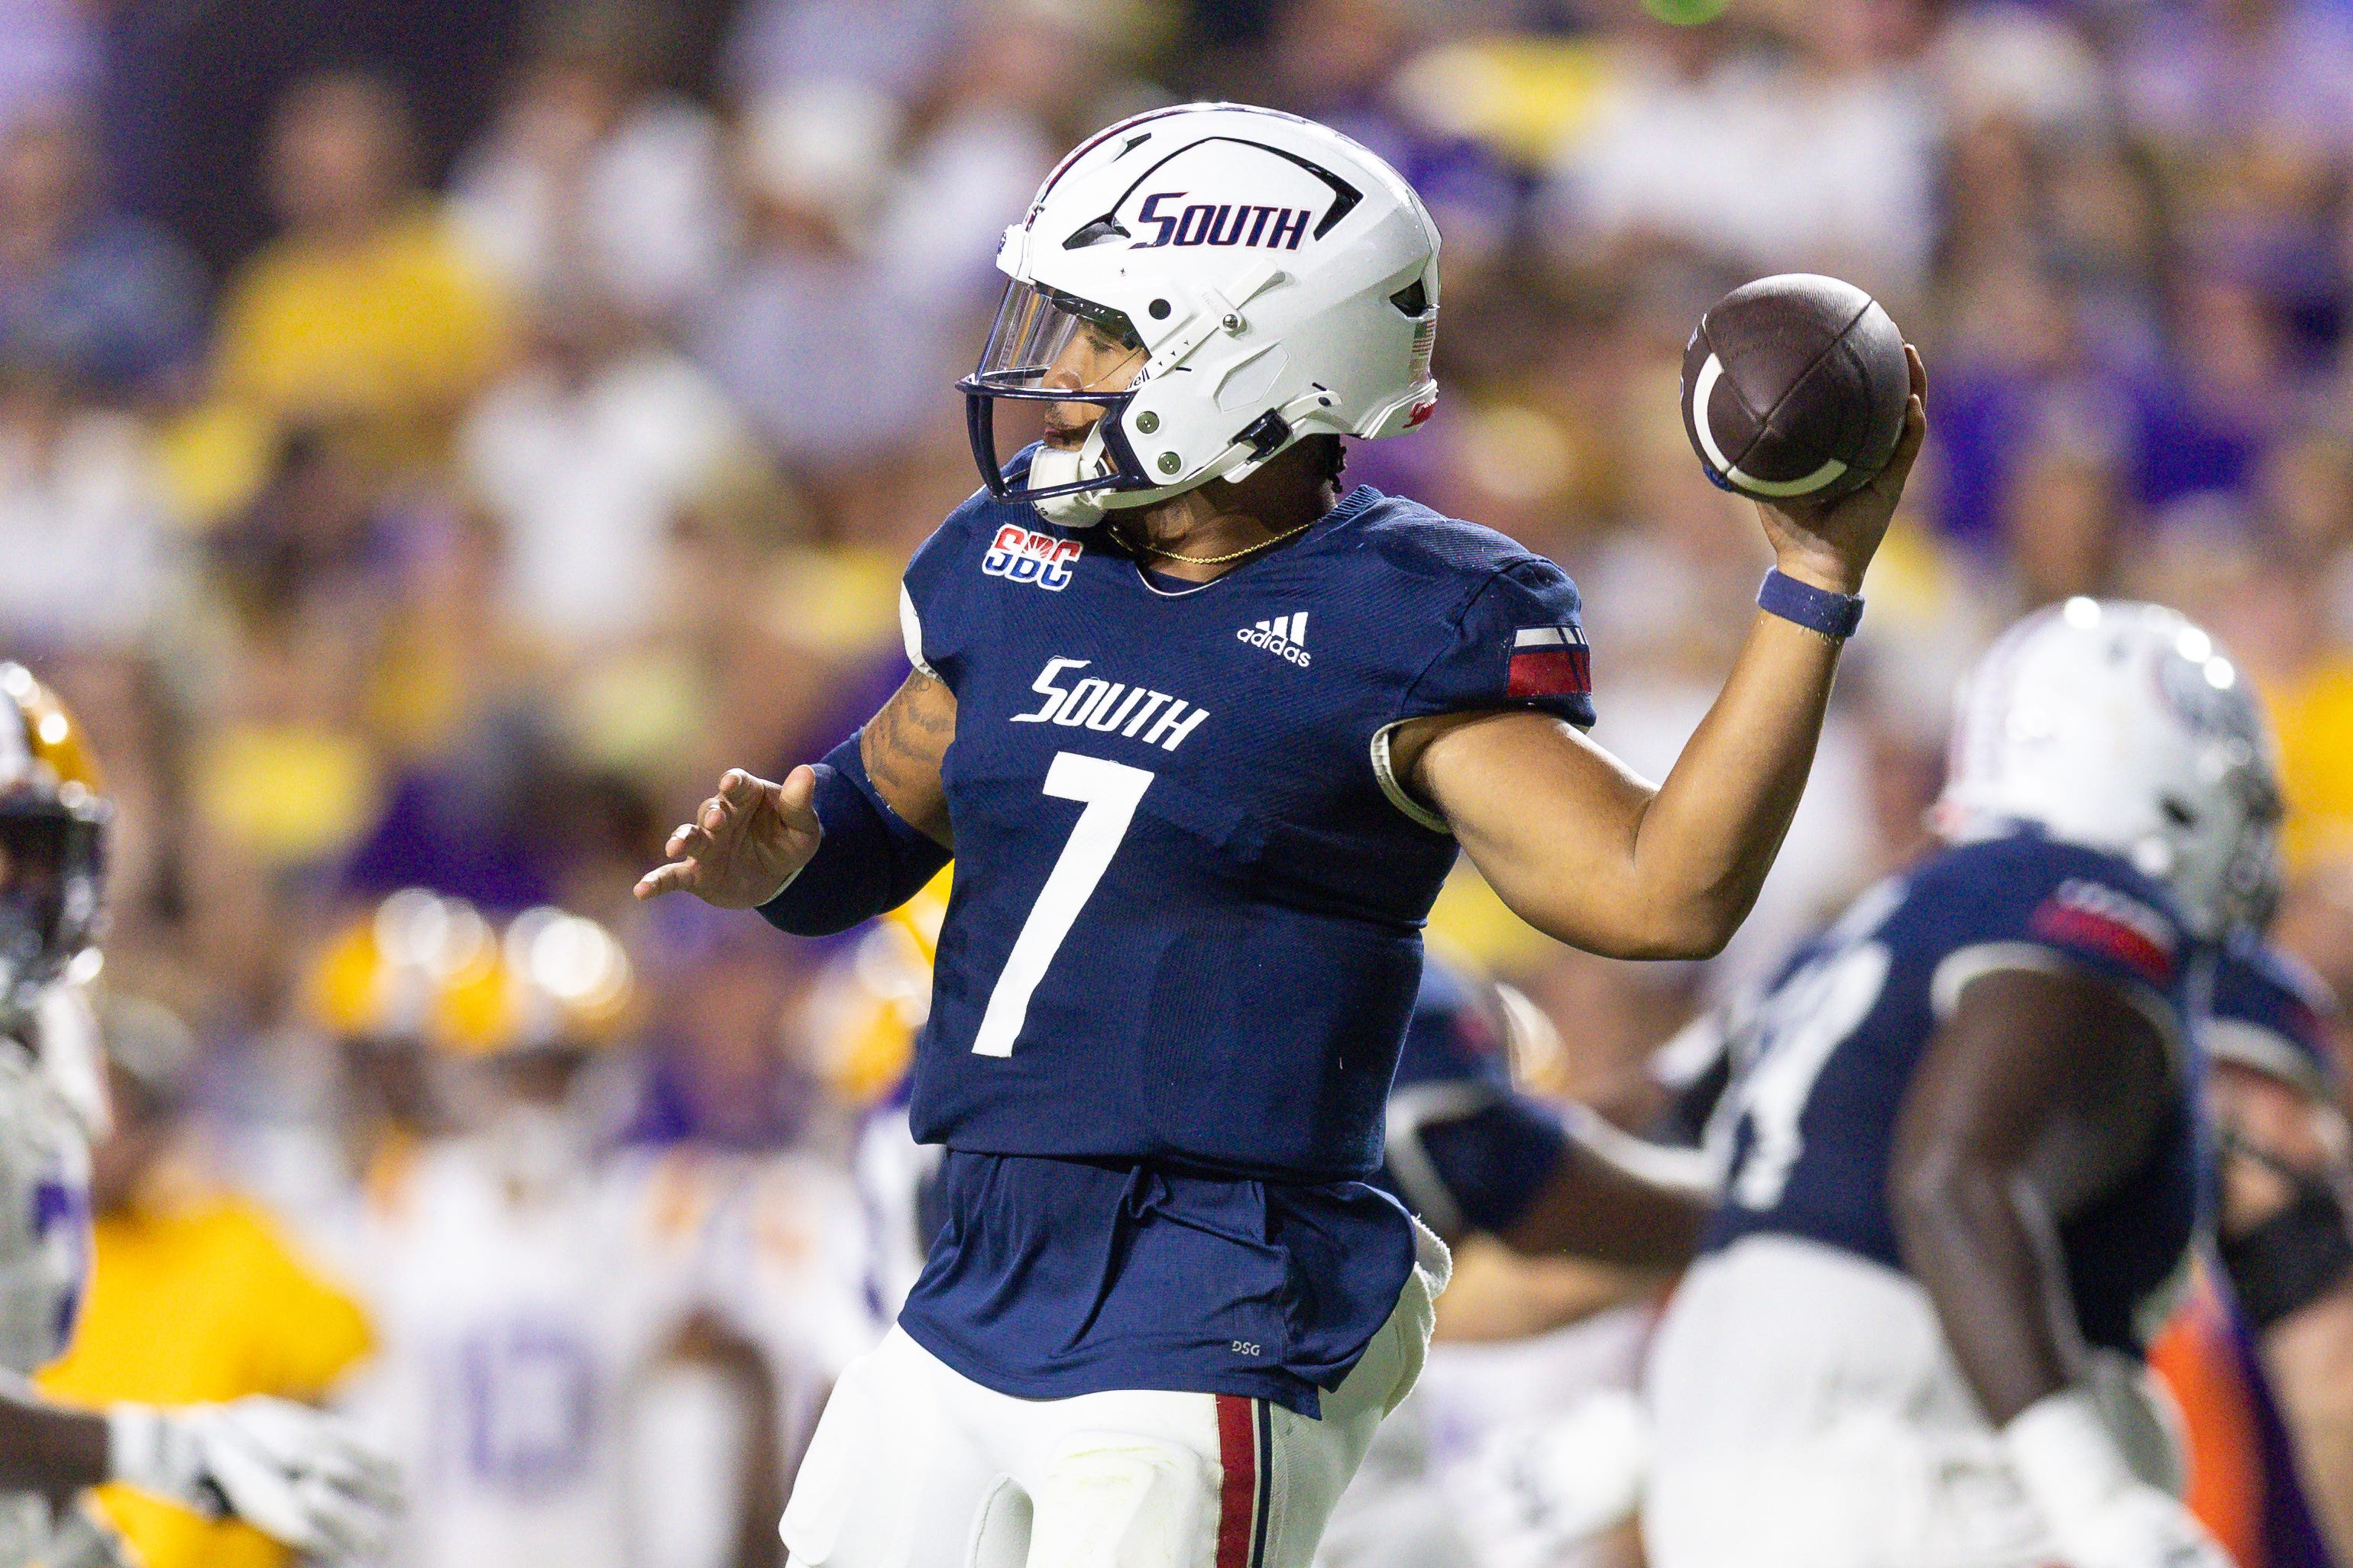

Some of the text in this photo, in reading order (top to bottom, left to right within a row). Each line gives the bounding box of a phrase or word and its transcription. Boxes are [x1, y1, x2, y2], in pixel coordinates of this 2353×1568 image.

[1129, 192, 1311, 250] SOUTH
[982, 525, 1083, 590] SBC
[1237, 626, 1311, 667] adidas
[1010, 657, 1210, 752] SOUTH
[972, 752, 1155, 1058] 7
[1232, 1340, 1261, 1356] DSG
